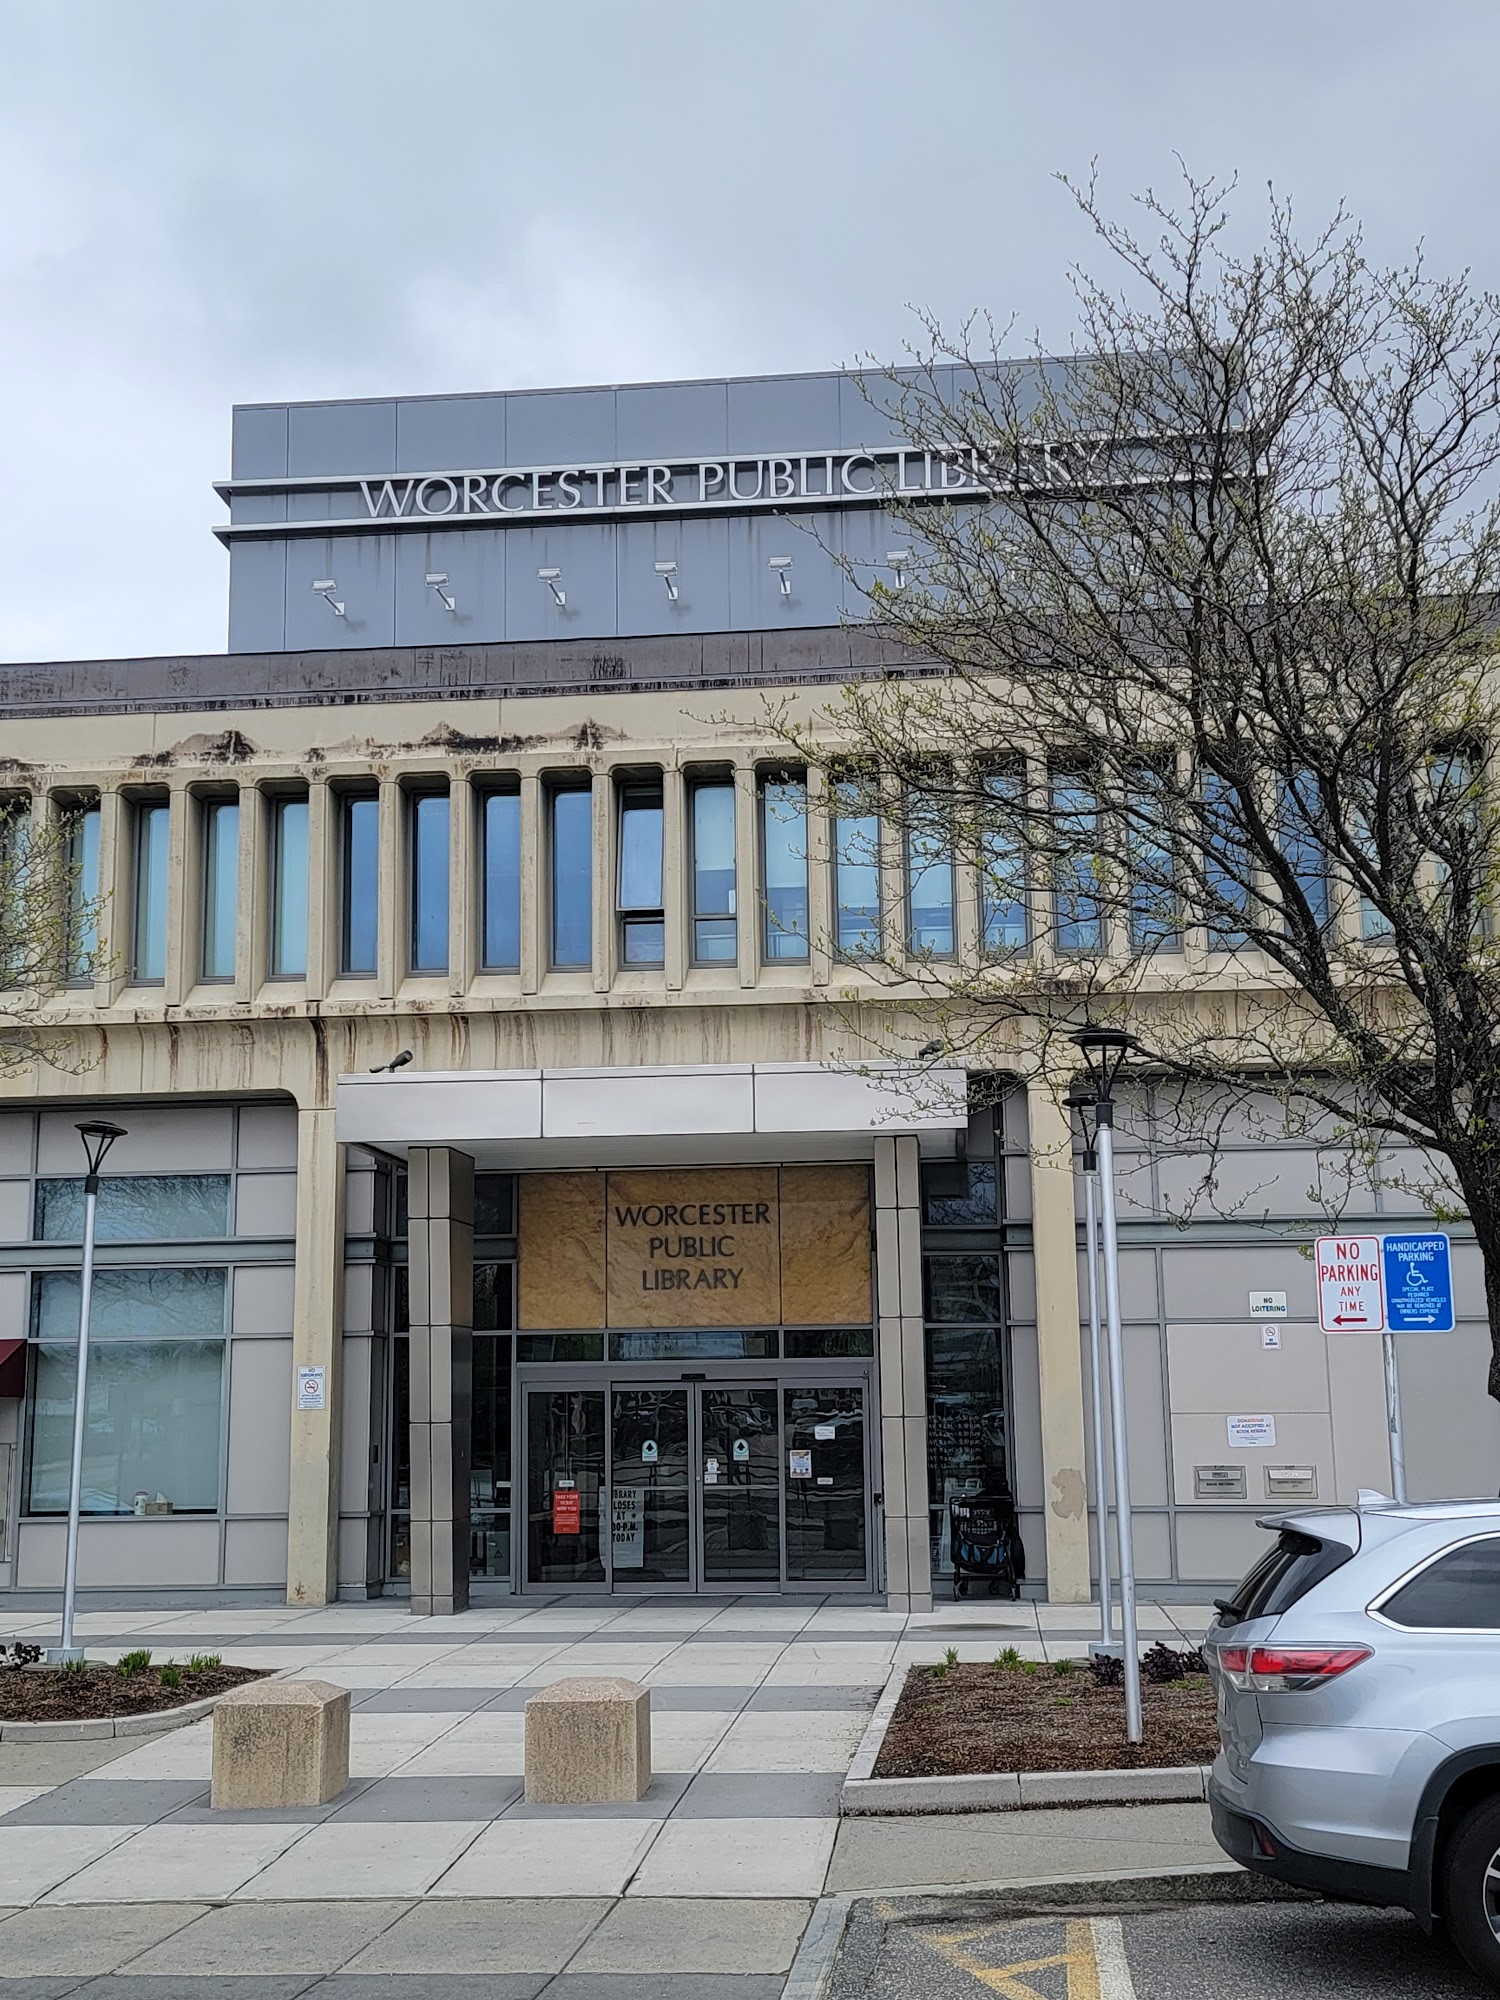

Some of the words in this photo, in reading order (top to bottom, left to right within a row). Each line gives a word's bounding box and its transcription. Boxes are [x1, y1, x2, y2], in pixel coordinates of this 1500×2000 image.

[360, 466, 675, 518] WORCESTER
[699, 455, 876, 501] PUBLIC
[615, 1203, 771, 1227] WORCESTER
[650, 1235, 735, 1259] PUBLIC
[1336, 1242, 1360, 1260] NO
[1386, 1241, 1445, 1252] HANDICAPPED
[1398, 1252, 1435, 1262] PARKING
[1321, 1263, 1378, 1282] PARKING
[642, 1267, 744, 1291] LIBRARY
[1340, 1286, 1361, 1297] ANY
[1339, 1301, 1365, 1312] TIME
[614, 1489, 637, 1499] BRARY
[613, 1500, 636, 1510] LOSES
[616, 1511, 626, 1521] AT
[611, 1532, 635, 1543] TODAY
